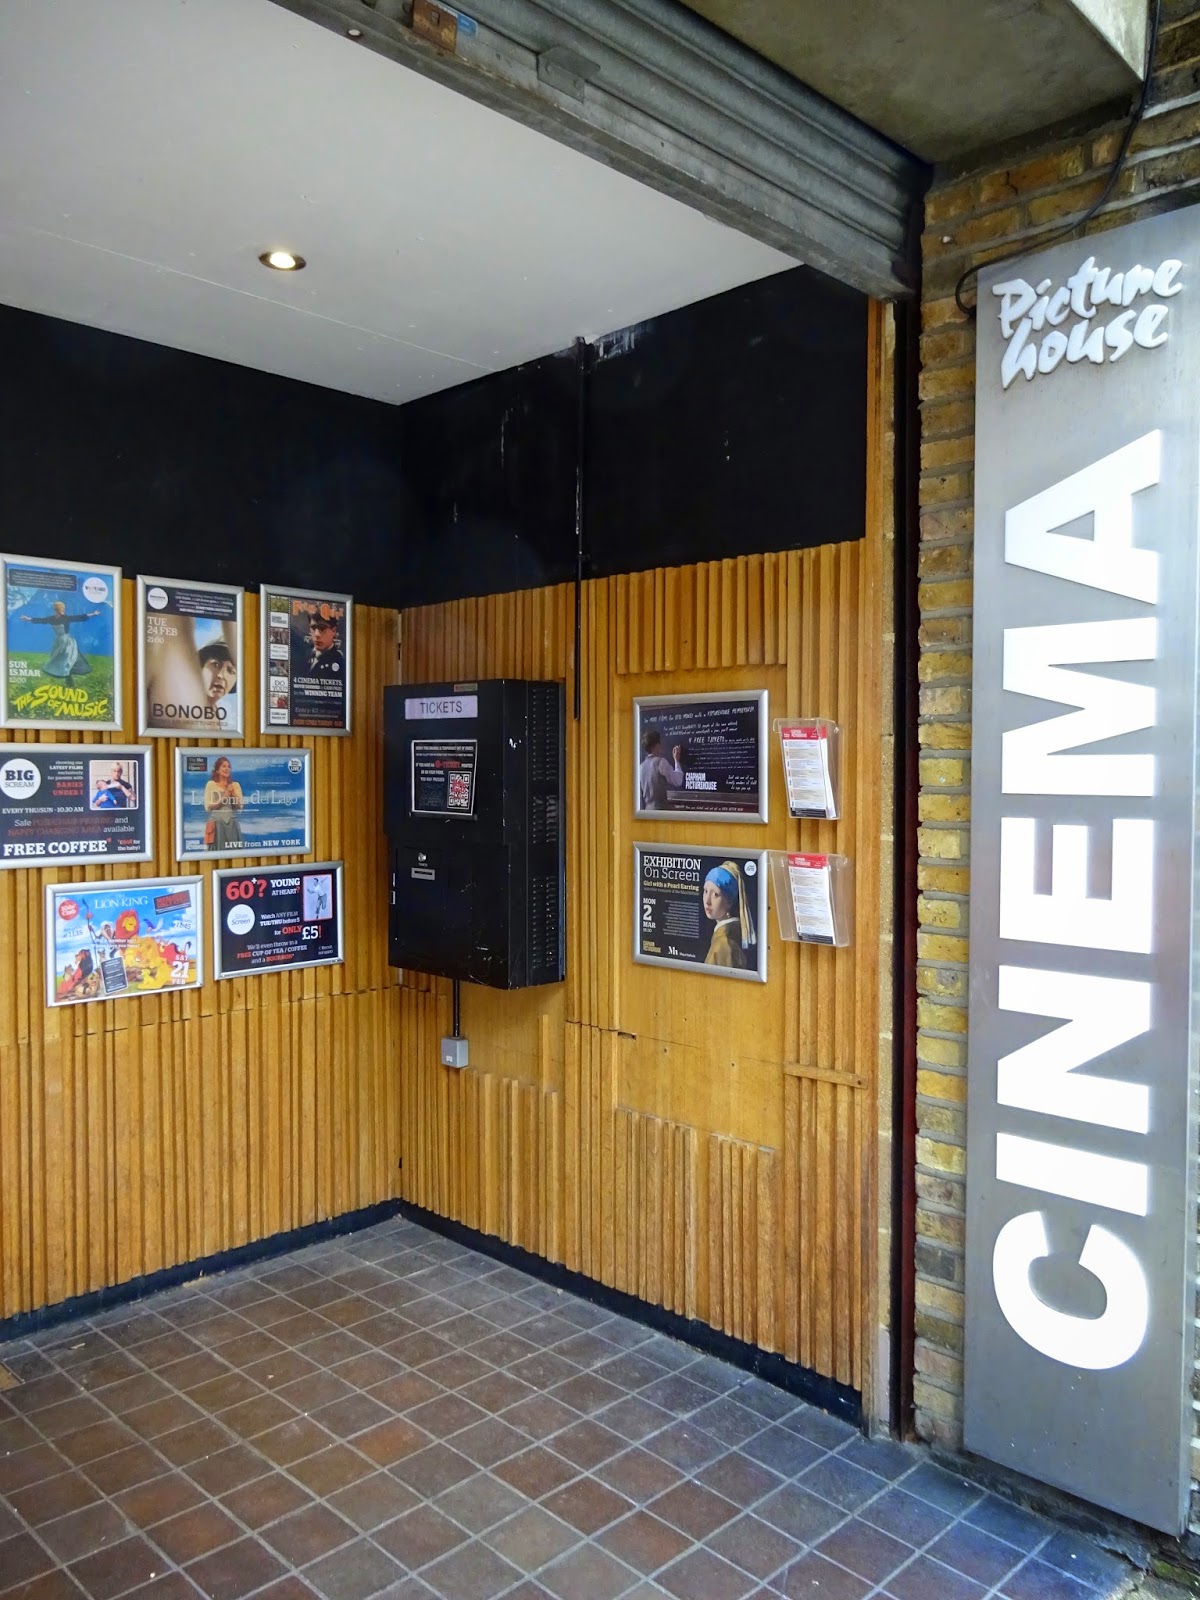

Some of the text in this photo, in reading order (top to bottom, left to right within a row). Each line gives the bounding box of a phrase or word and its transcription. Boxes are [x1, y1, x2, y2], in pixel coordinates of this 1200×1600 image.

[992, 256, 1183, 339] Picture
[1001, 304, 1168, 390] house
[147, 616, 168, 627] TUE
[147, 626, 178, 637] 24 FEB
[9, 661, 27, 669] SUN
[20, 669, 41, 677] MAR
[298, 677, 320, 685] CINEMA
[11, 685, 88, 711] THE SOUND
[48, 700, 61, 709] OF
[420, 701, 463, 714] TICKETS
[153, 703, 227, 721] BONOBO
[5, 770, 35, 781] BIG
[685, 781, 717, 790] PICTUREHOUSE
[210, 790, 250, 805] Donna
[271, 790, 298, 806] Lago
[14, 819, 32, 827] Safe
[103, 825, 135, 833] available
[3, 842, 46, 856] FREE
[643, 855, 701, 870] EXHIBITION
[644, 866, 700, 881] On Screen
[270, 878, 301, 888] YOUNG
[680, 883, 700, 891] Earring
[95, 899, 119, 909] LION
[121, 896, 148, 908] KING
[643, 897, 656, 905] MON
[993, 429, 1161, 1371] CINEMA
[643, 904, 652, 921] 2
[282, 925, 303, 935] ONLY
[170, 961, 190, 978] 21
